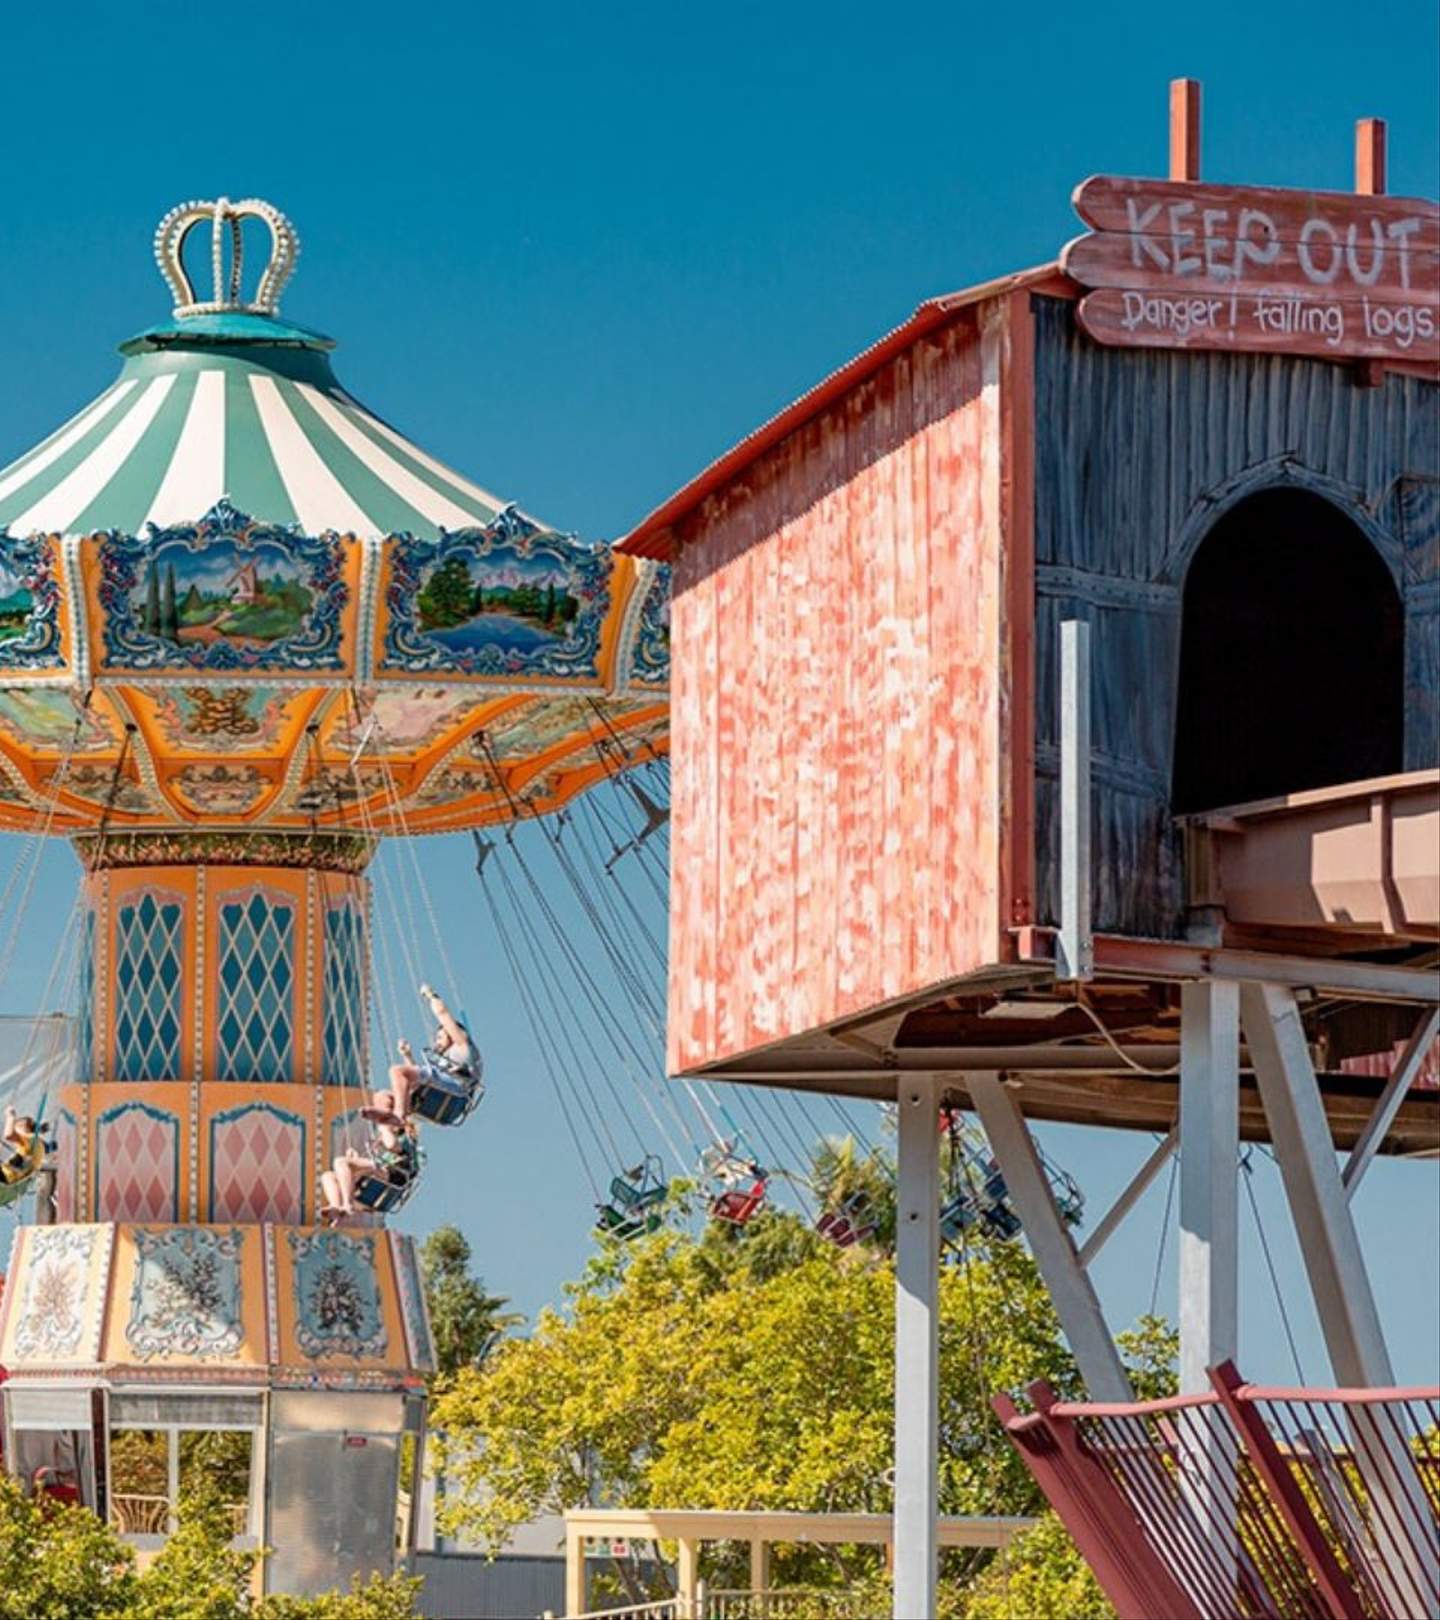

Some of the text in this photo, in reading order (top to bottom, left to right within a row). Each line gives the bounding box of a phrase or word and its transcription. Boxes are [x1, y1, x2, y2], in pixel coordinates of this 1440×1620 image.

[1127, 198, 1422, 294] KEEP OUT
[1253, 291, 1344, 345] falling
